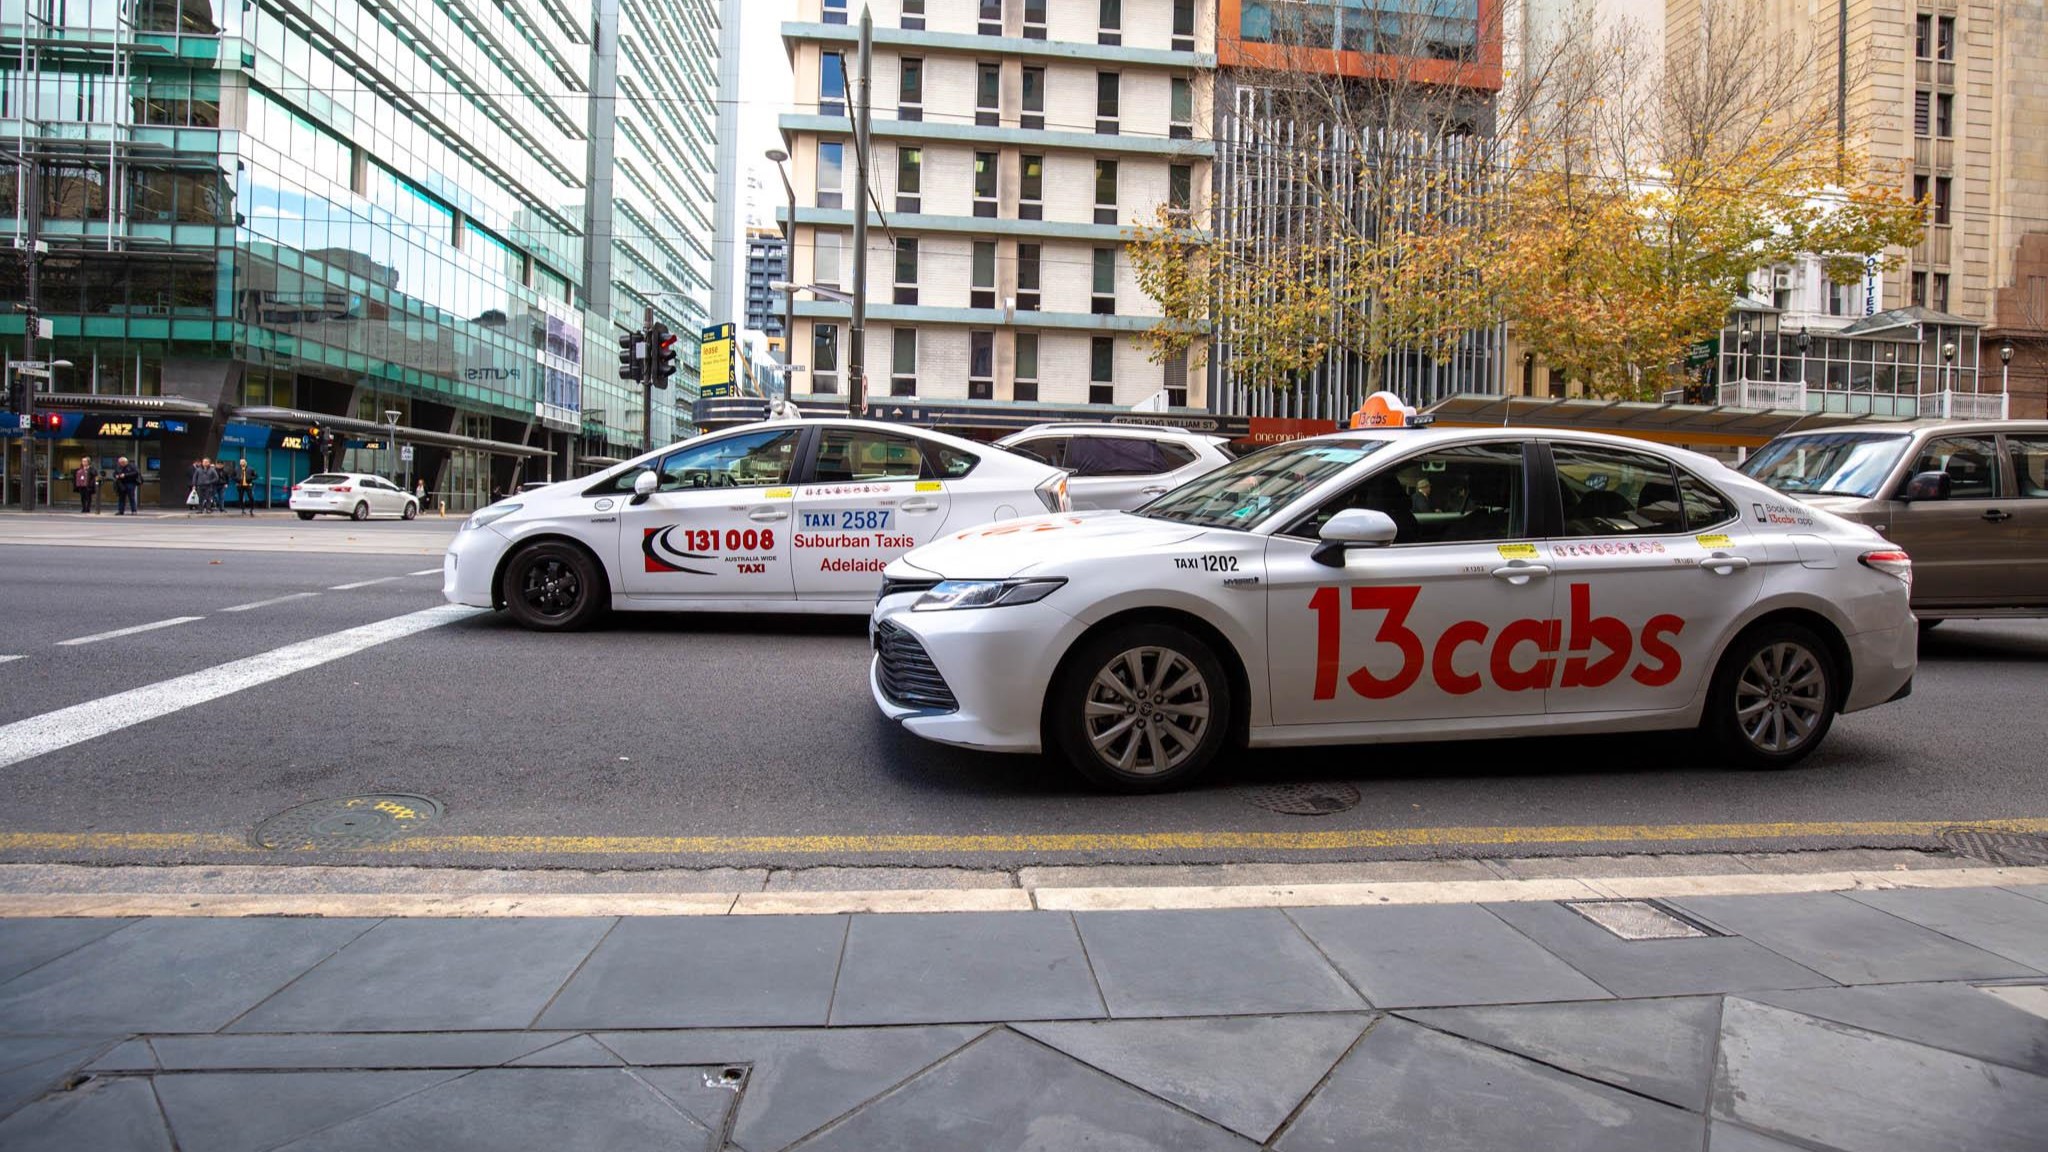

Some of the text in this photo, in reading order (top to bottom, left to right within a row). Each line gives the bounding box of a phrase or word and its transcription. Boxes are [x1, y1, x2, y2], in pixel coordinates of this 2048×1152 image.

[145, 420, 159, 429] ANZ
[1167, 420, 1200, 428] WILLIAM
[1359, 411, 1388, 425] 13cabs
[98, 423, 133, 436] ANZ
[281, 436, 302, 449] ANZ
[1255, 432, 1274, 442] one
[1275, 433, 1295, 442] one
[804, 511, 890, 529] TAXI 2587
[685, 529, 775, 551] 131 008
[794, 534, 915, 548] Suburban Taxis
[737, 563, 766, 574] TAXI
[820, 558, 888, 572] Adelaide
[1174, 554, 1239, 572] TAXI 1202
[1308, 582, 1686, 701] 13cabs
